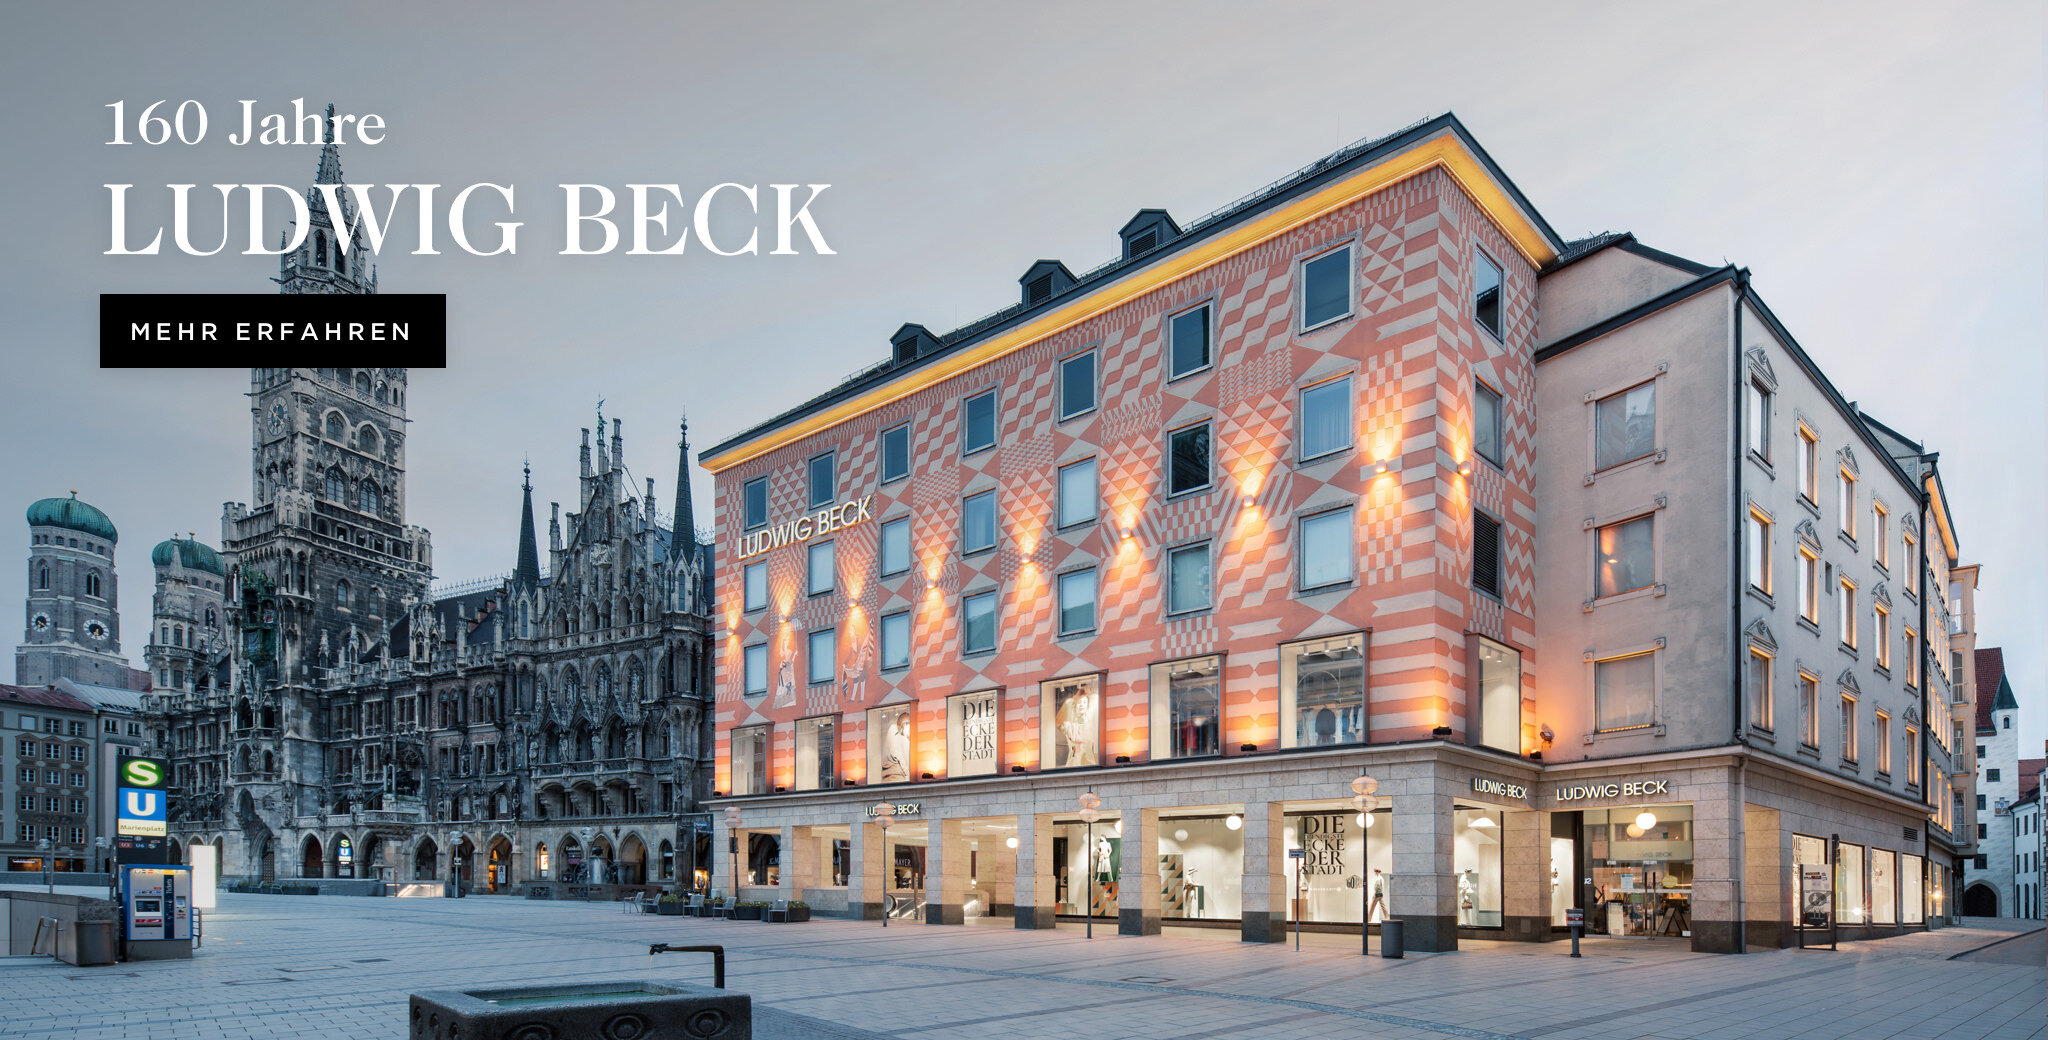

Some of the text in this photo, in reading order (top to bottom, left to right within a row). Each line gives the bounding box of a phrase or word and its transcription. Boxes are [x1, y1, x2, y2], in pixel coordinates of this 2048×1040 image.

[738, 494, 872, 559] LUDWIG BECK
[963, 699, 995, 720] DIE
[963, 723, 995, 737] ECKE
[963, 735, 995, 751] DER
[962, 749, 994, 760] STADT
[128, 760, 158, 786] S
[1475, 777, 1528, 799] LUDWIG BECK
[1556, 779, 1669, 801] LUDWIG BECK
[127, 791, 156, 816] U
[865, 803, 920, 816] LUG BECK
[120, 824, 165, 832] Marienplatz
[1304, 816, 1345, 834] DIE
[340, 848, 350, 856] U
[1304, 839, 1345, 851] ECKE
[1304, 851, 1345, 867] DER
[1302, 865, 1343, 875] STADT
